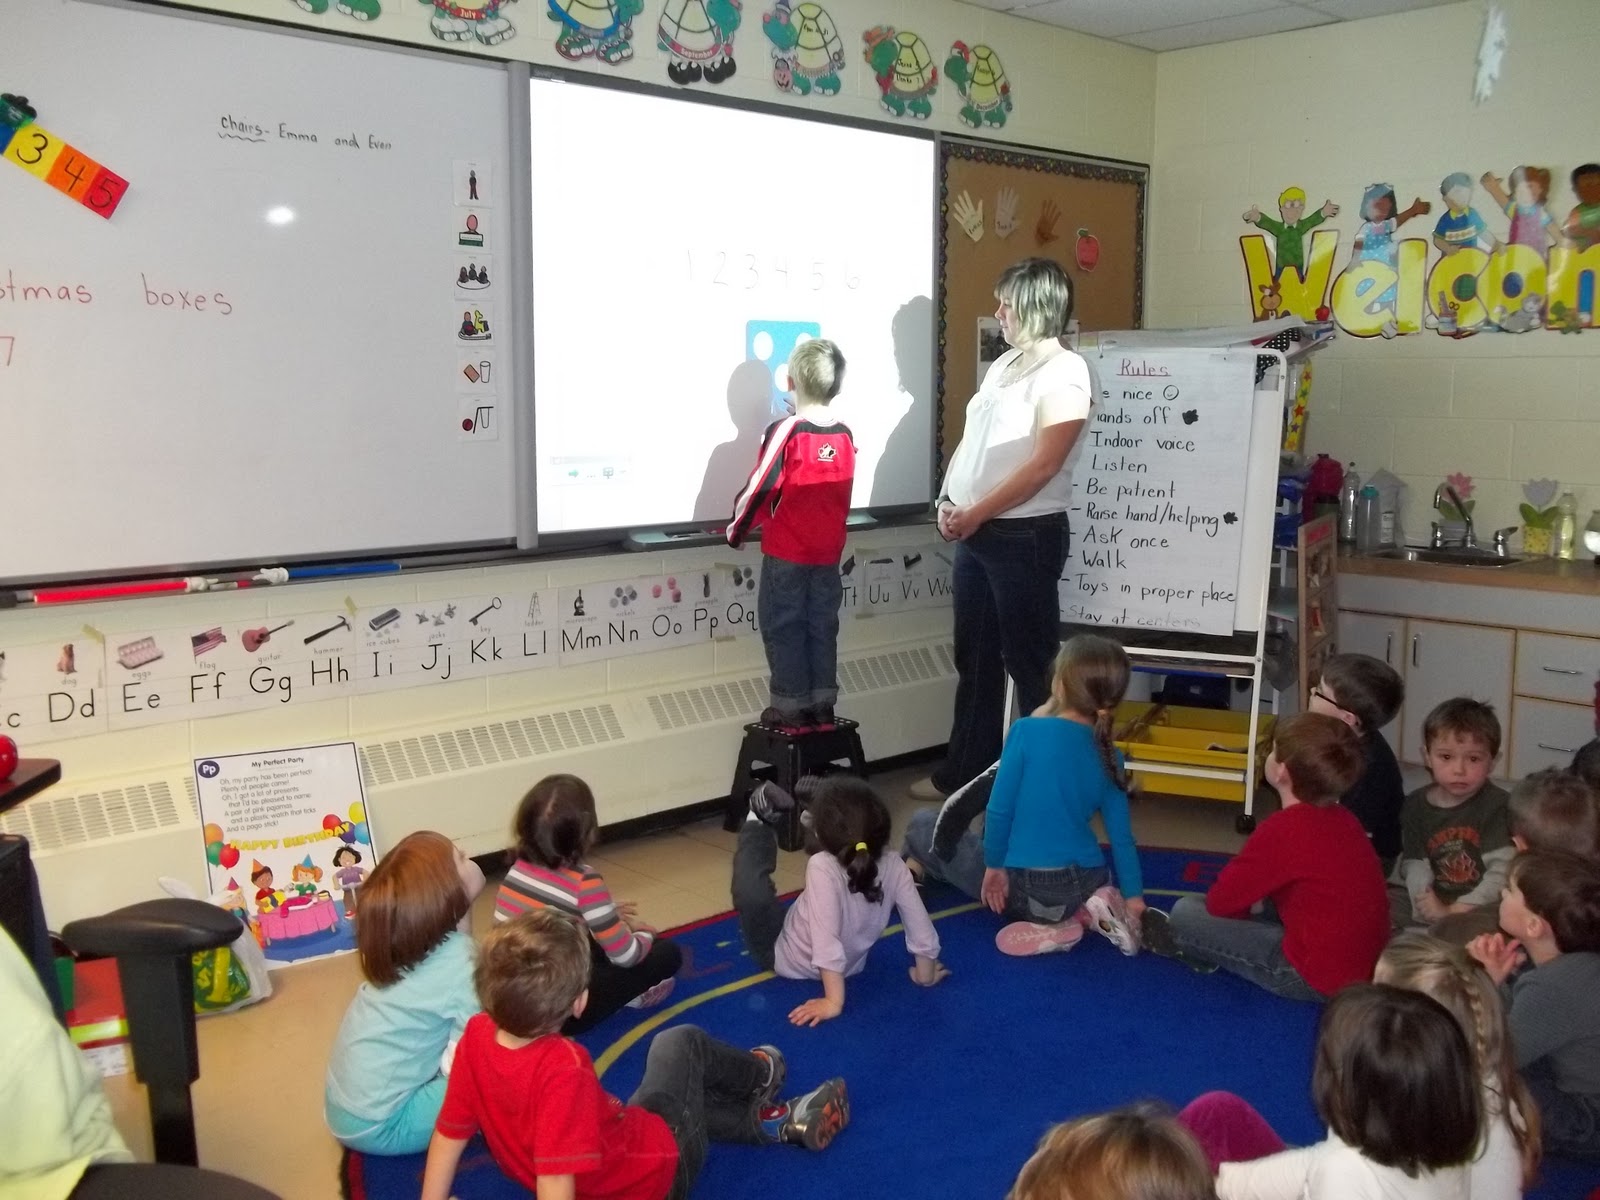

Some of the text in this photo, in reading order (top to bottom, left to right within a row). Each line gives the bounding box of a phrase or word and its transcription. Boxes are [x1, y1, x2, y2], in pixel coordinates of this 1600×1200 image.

[460, 9, 476, 19] July
[279, 123, 317, 142] Emma
[335, 133, 360, 149] and
[17, 134, 120, 208] 3 4 5
[713, 251, 729, 286] 2
[744, 253, 759, 290] 3
[774, 256, 789, 290] 4
[812, 262, 824, 291] 5
[845, 260, 861, 290] 6
[141, 272, 232, 315] boxes
[1121, 358, 1169, 376] Rules
[1123, 386, 1152, 400] nice
[1144, 406, 1170, 424] off
[1090, 431, 1142, 448] Indoor
[1092, 454, 1147, 473] Listen
[1087, 478, 1176, 501] Be patient
[1087, 502, 1117, 520] Raise
[1130, 536, 1169, 549] once
[1083, 549, 1126, 568] Walk
[1076, 573, 1109, 596] Toys
[1121, 580, 1131, 593] in
[1141, 586, 1194, 603] proper
[1067, 605, 1102, 623] Stay
[1112, 608, 1129, 624] at
[480, 626, 491, 634] key
[380, 638, 400, 646] cubes
[49, 688, 94, 722] Dd
[123, 682, 160, 712] Ee
[191, 672, 226, 702] Ff
[250, 666, 292, 702] Gg
[312, 656, 348, 686] Hh
[421, 643, 450, 680] Jj
[471, 636, 502, 663] Kk
[562, 626, 601, 652] Mm
[609, 620, 638, 644] Nn
[652, 614, 682, 637] Oo
[694, 608, 718, 638] Pp
[727, 603, 758, 631] Qq
[870, 584, 890, 604] Uu
[901, 580, 920, 599] Vv
[258, 654, 282, 665] guitar
[200, 662, 216, 671] flag
[202, 764, 216, 775] Pp
[264, 758, 286, 766] Perfect
[239, 792, 249, 800] got
[274, 786, 299, 795] presents
[249, 782, 270, 790] people
[261, 796, 284, 805] pleased
[245, 806, 250, 814] of
[252, 805, 264, 813] pink
[250, 813, 268, 822] plastic
[230, 823, 350, 850] HAPPY BIRTHDAY
